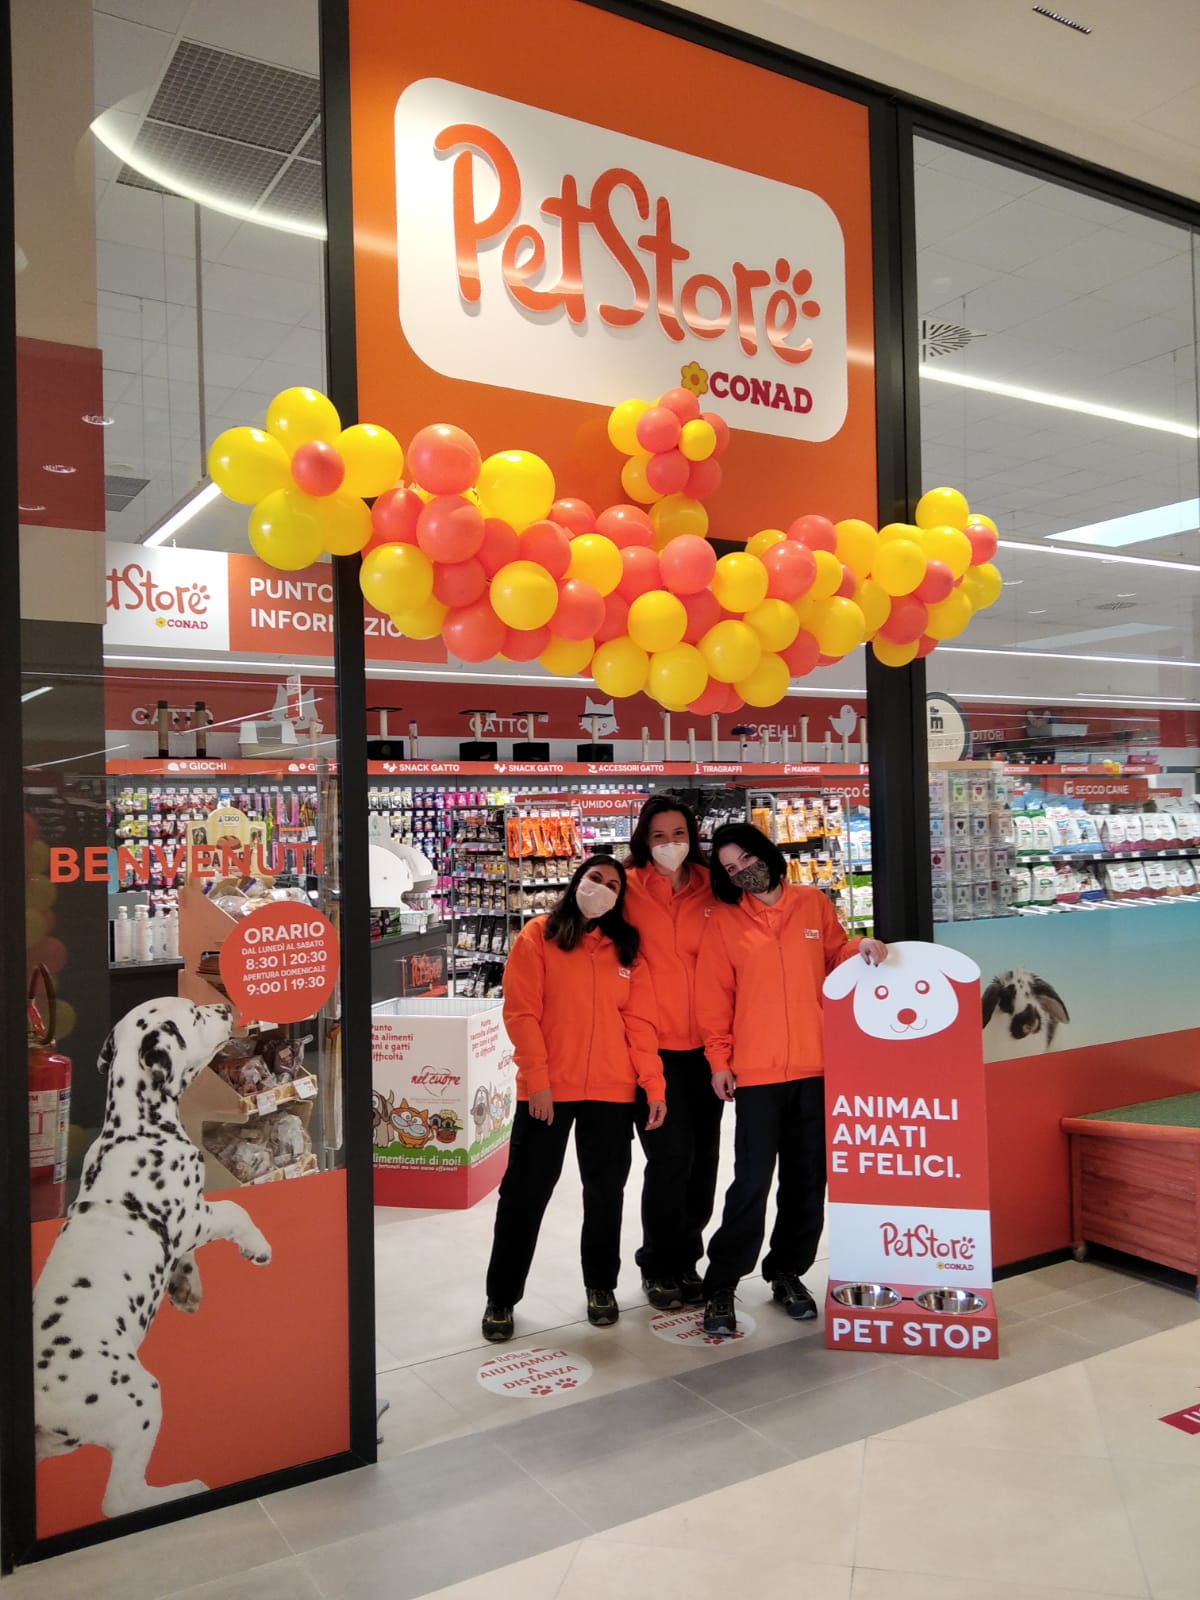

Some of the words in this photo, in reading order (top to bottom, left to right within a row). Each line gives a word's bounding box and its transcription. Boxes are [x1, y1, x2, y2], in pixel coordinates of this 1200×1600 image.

[432, 123, 817, 364] PetStore
[708, 371, 813, 414] CONAD
[105, 563, 208, 615] tStore
[250, 577, 334, 603] PUNTO
[166, 619, 209, 630] CONAD
[188, 762, 227, 771] GIOCHI
[399, 764, 430, 772] SNACK
[431, 764, 460, 772] GATTO
[508, 764, 536, 773] SNACK
[537, 765, 564, 773] GATTO
[598, 764, 639, 772] ACCESSORI
[640, 764, 665, 772] GATTO
[1075, 784, 1105, 795] SECCO
[1107, 784, 1129, 795] CANE
[582, 799, 614, 810] UMIDO
[50, 843, 324, 884] BENVENUTI
[243, 921, 325, 945] ORARIO
[241, 947, 257, 956] DAL
[286, 943, 296, 951] AL
[296, 940, 324, 950] SABATO
[245, 955, 278, 971] 8:30
[289, 950, 328, 965] 20:30
[242, 971, 280, 982] APERTURA
[280, 965, 328, 977] DOMENICALE
[246, 981, 281, 996] 9:00
[291, 975, 326, 991] 19:30
[381, 1032, 414, 1042] alimenti
[391, 1043, 410, 1053] gatti
[831, 1095, 959, 1121] ANIMALI
[831, 1123, 927, 1148] AMATI
[429, 1155, 439, 1166] di
[442, 1155, 461, 1166] noi!
[832, 1151, 849, 1173] E
[858, 1152, 962, 1179] FELICI.
[879, 1222, 975, 1261] PetStore
[944, 1262, 975, 1271] CONAD
[832, 1318, 895, 1345] PET
[902, 1321, 993, 1351] STOP
[480, 1350, 569, 1379] AIUTIAMOCI
[527, 1367, 540, 1375] A
[502, 1365, 580, 1390] DISTANZA
